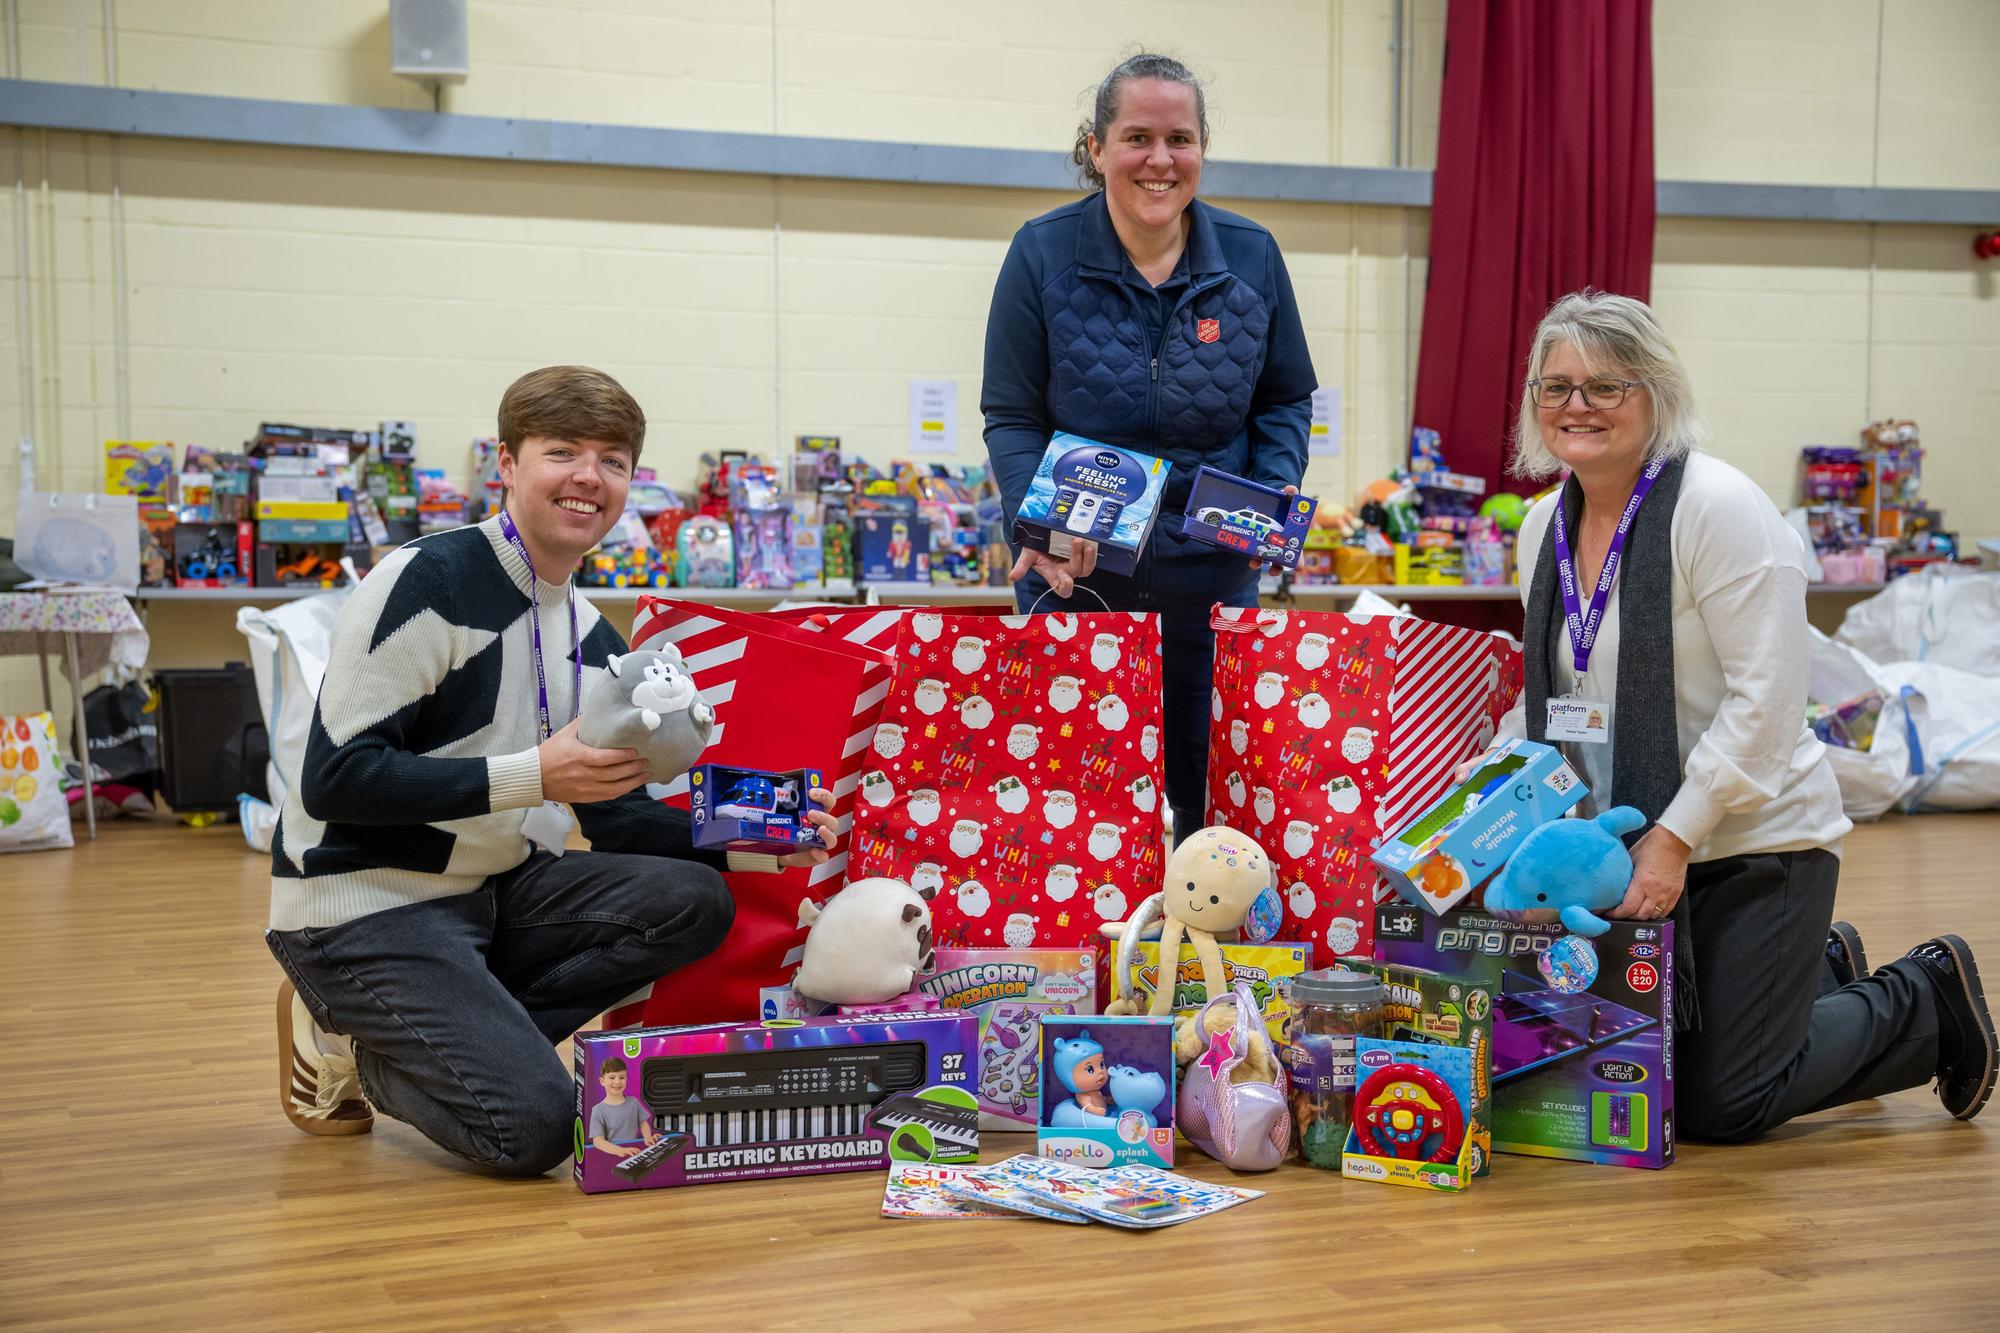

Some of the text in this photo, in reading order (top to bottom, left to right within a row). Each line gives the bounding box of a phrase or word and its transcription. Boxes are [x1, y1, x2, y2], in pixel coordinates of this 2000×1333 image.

[1097, 455, 1119, 465] NIVEA
[1075, 466, 1127, 485] FEELING
[1078, 474, 1119, 490] FRESH
[1618, 494, 1640, 534] platform
[1216, 529, 1252, 550] CREW
[1221, 524, 1255, 537] EMERGENCY
[1560, 558, 1574, 597] platform
[1598, 551, 1617, 592] platform
[1569, 612, 1581, 642] platfo
[1580, 608, 1599, 650] platform
[535, 648, 545, 689] platform
[997, 658, 1041, 680] WHAT
[1220, 652, 1249, 678] WHAT
[1337, 655, 1384, 682] WHAT
[1550, 704, 1587, 714] platform
[941, 749, 986, 777] WHAT
[1081, 751, 1126, 780] WHAT
[1279, 747, 1323, 778] WHAT
[766, 817, 792, 825] EMERGENCY
[1471, 809, 1518, 851] Waterfall
[765, 825, 791, 840] CREW
[1485, 823, 1518, 851] Whale
[860, 837, 905, 863] WHAT
[993, 843, 1041, 868] WHAT
[1321, 843, 1368, 872] WHAT
[1381, 915, 1413, 933] LED
[1458, 916, 1563, 934] championship
[1436, 929, 1552, 955] ping po
[1081, 957, 1091, 965] 5+
[1234, 966, 1266, 982] THEIR
[1633, 967, 1651, 976] 2 for
[922, 964, 1038, 1000] UNICORN
[1632, 976, 1653, 986] £20
[942, 981, 1027, 1009] OPERATION
[836, 1011, 961, 1025] KEYBOARD
[942, 1054, 964, 1070] 37
[1362, 1053, 1390, 1064] try me
[940, 1071, 967, 1083] KEYS
[1602, 1064, 1635, 1073] LIGHT UP
[1604, 1070, 1633, 1080] ACTION!
[1319, 1077, 1328, 1085] 3+
[1541, 1101, 1587, 1113] SET INCLUDES
[1608, 1135, 1619, 1144] 60
[685, 1139, 884, 1170] ELECTRIC KEYBOARD
[937, 1145, 962, 1153] INCLUDES
[1045, 1144, 1149, 1162] hapello splash
[792, 1164, 823, 1172] MICROPHONE
[1389, 1170, 1416, 1180] steering
